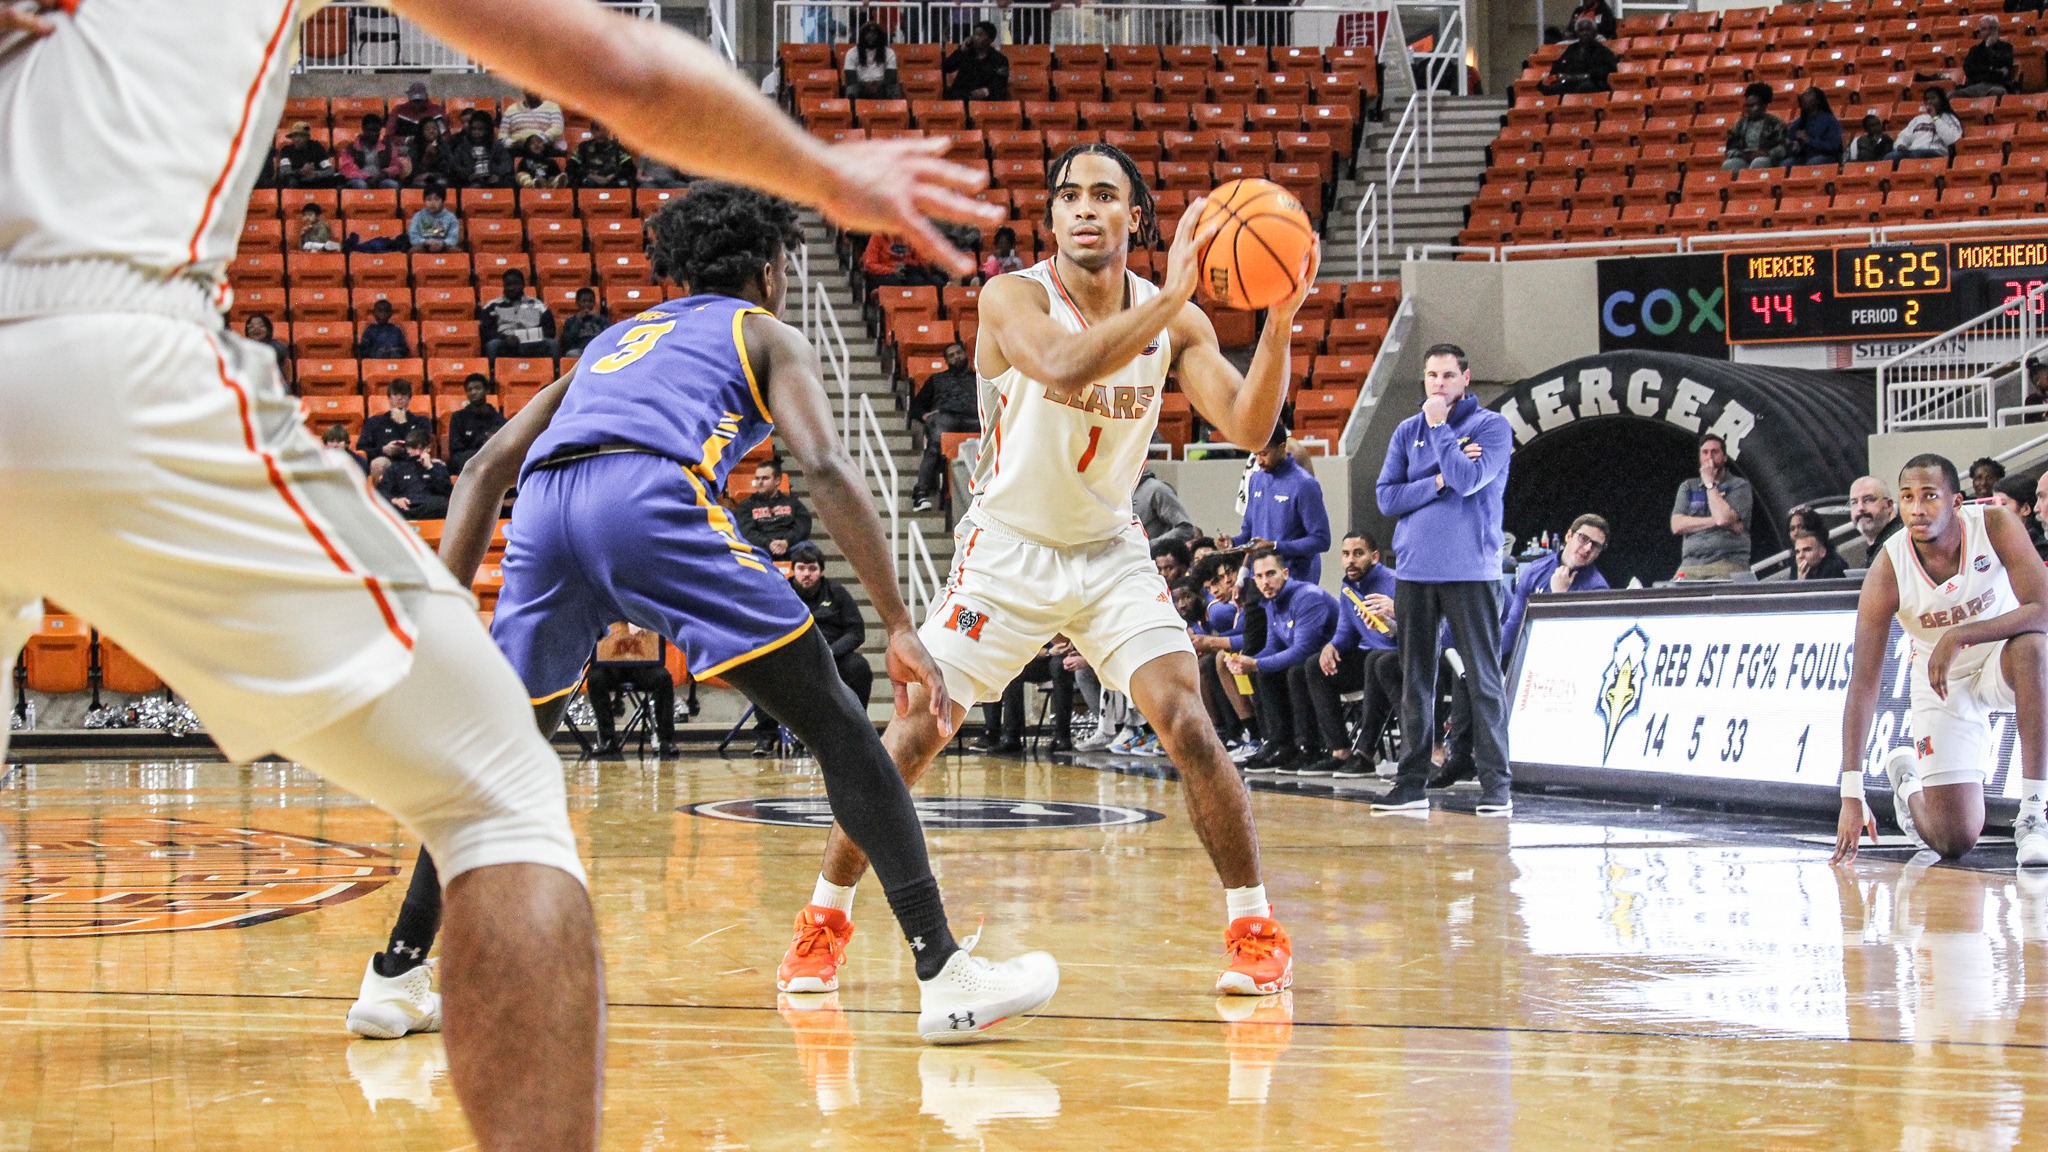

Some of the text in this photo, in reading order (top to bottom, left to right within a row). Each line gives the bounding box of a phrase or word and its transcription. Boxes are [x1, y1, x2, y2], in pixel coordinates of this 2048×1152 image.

[1750, 255, 1815, 279] MERCER
[1854, 251, 1941, 289] 16:25
[1958, 243, 2047, 269] MOREHEAD
[1602, 286, 1726, 337] COX
[1751, 294, 1793, 324] 44
[1851, 300, 1919, 325] PERIOD 2
[590, 319, 677, 374] 3
[1077, 426, 1102, 472] 1
[1919, 588, 1996, 628] BEARS
[1652, 643, 1692, 687] REB
[1733, 643, 1780, 689] FG%
[1786, 643, 1854, 691] FOULS
[1643, 713, 1810, 773] 14 5 33 1
